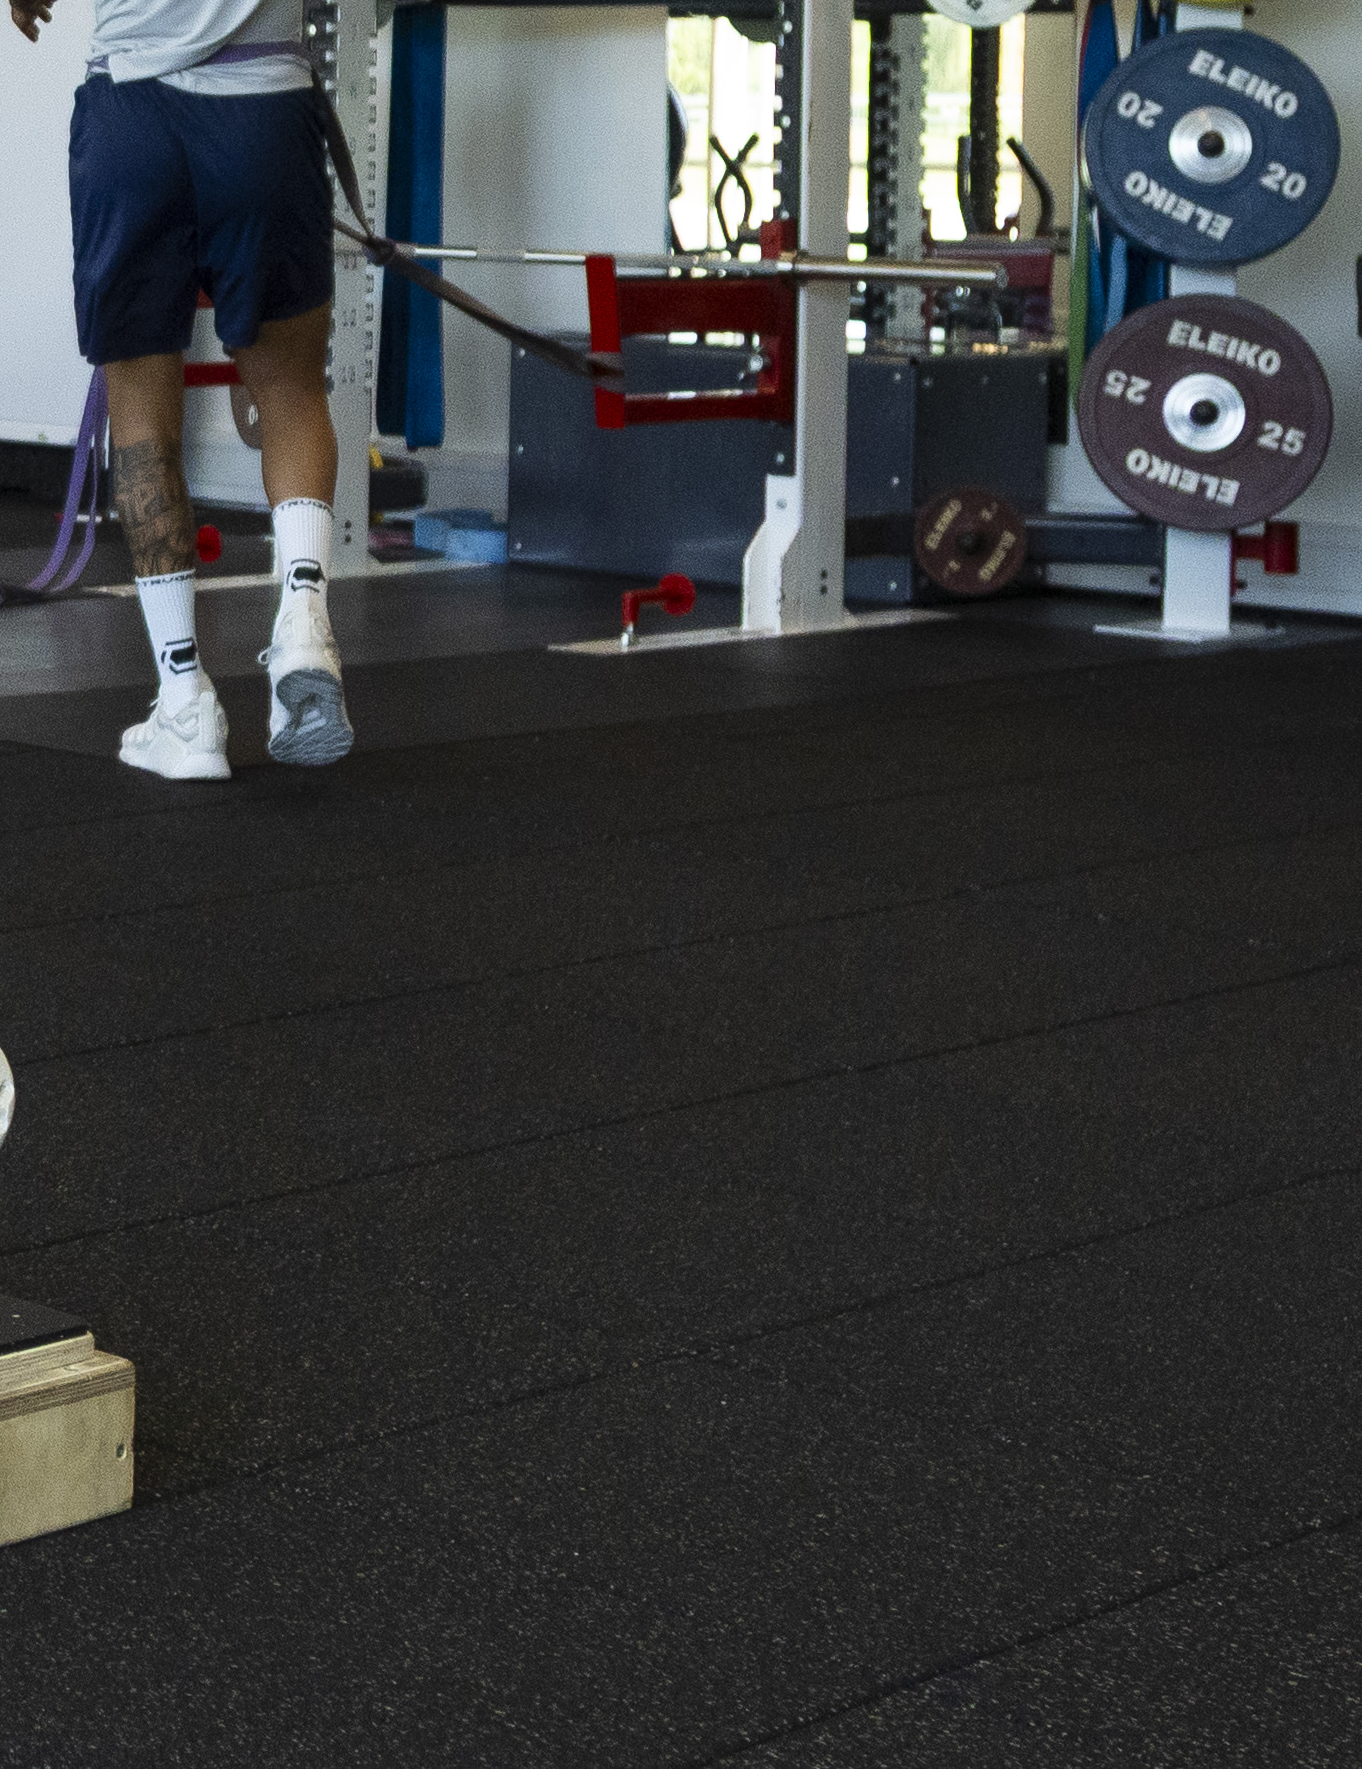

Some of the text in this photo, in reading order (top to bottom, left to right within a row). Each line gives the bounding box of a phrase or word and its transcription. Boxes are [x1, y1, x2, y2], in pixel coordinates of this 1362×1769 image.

[1188, 49, 1298, 119] ELEIKO
[1117, 92, 1163, 129] 20
[1261, 162, 1307, 200] 20
[1125, 171, 1233, 241] ELEIKO
[1167, 320, 1281, 376] ELEIKO
[1103, 369, 1151, 404] 25
[1257, 421, 1306, 456] 25
[1126, 448, 1240, 506] ELEIKO
